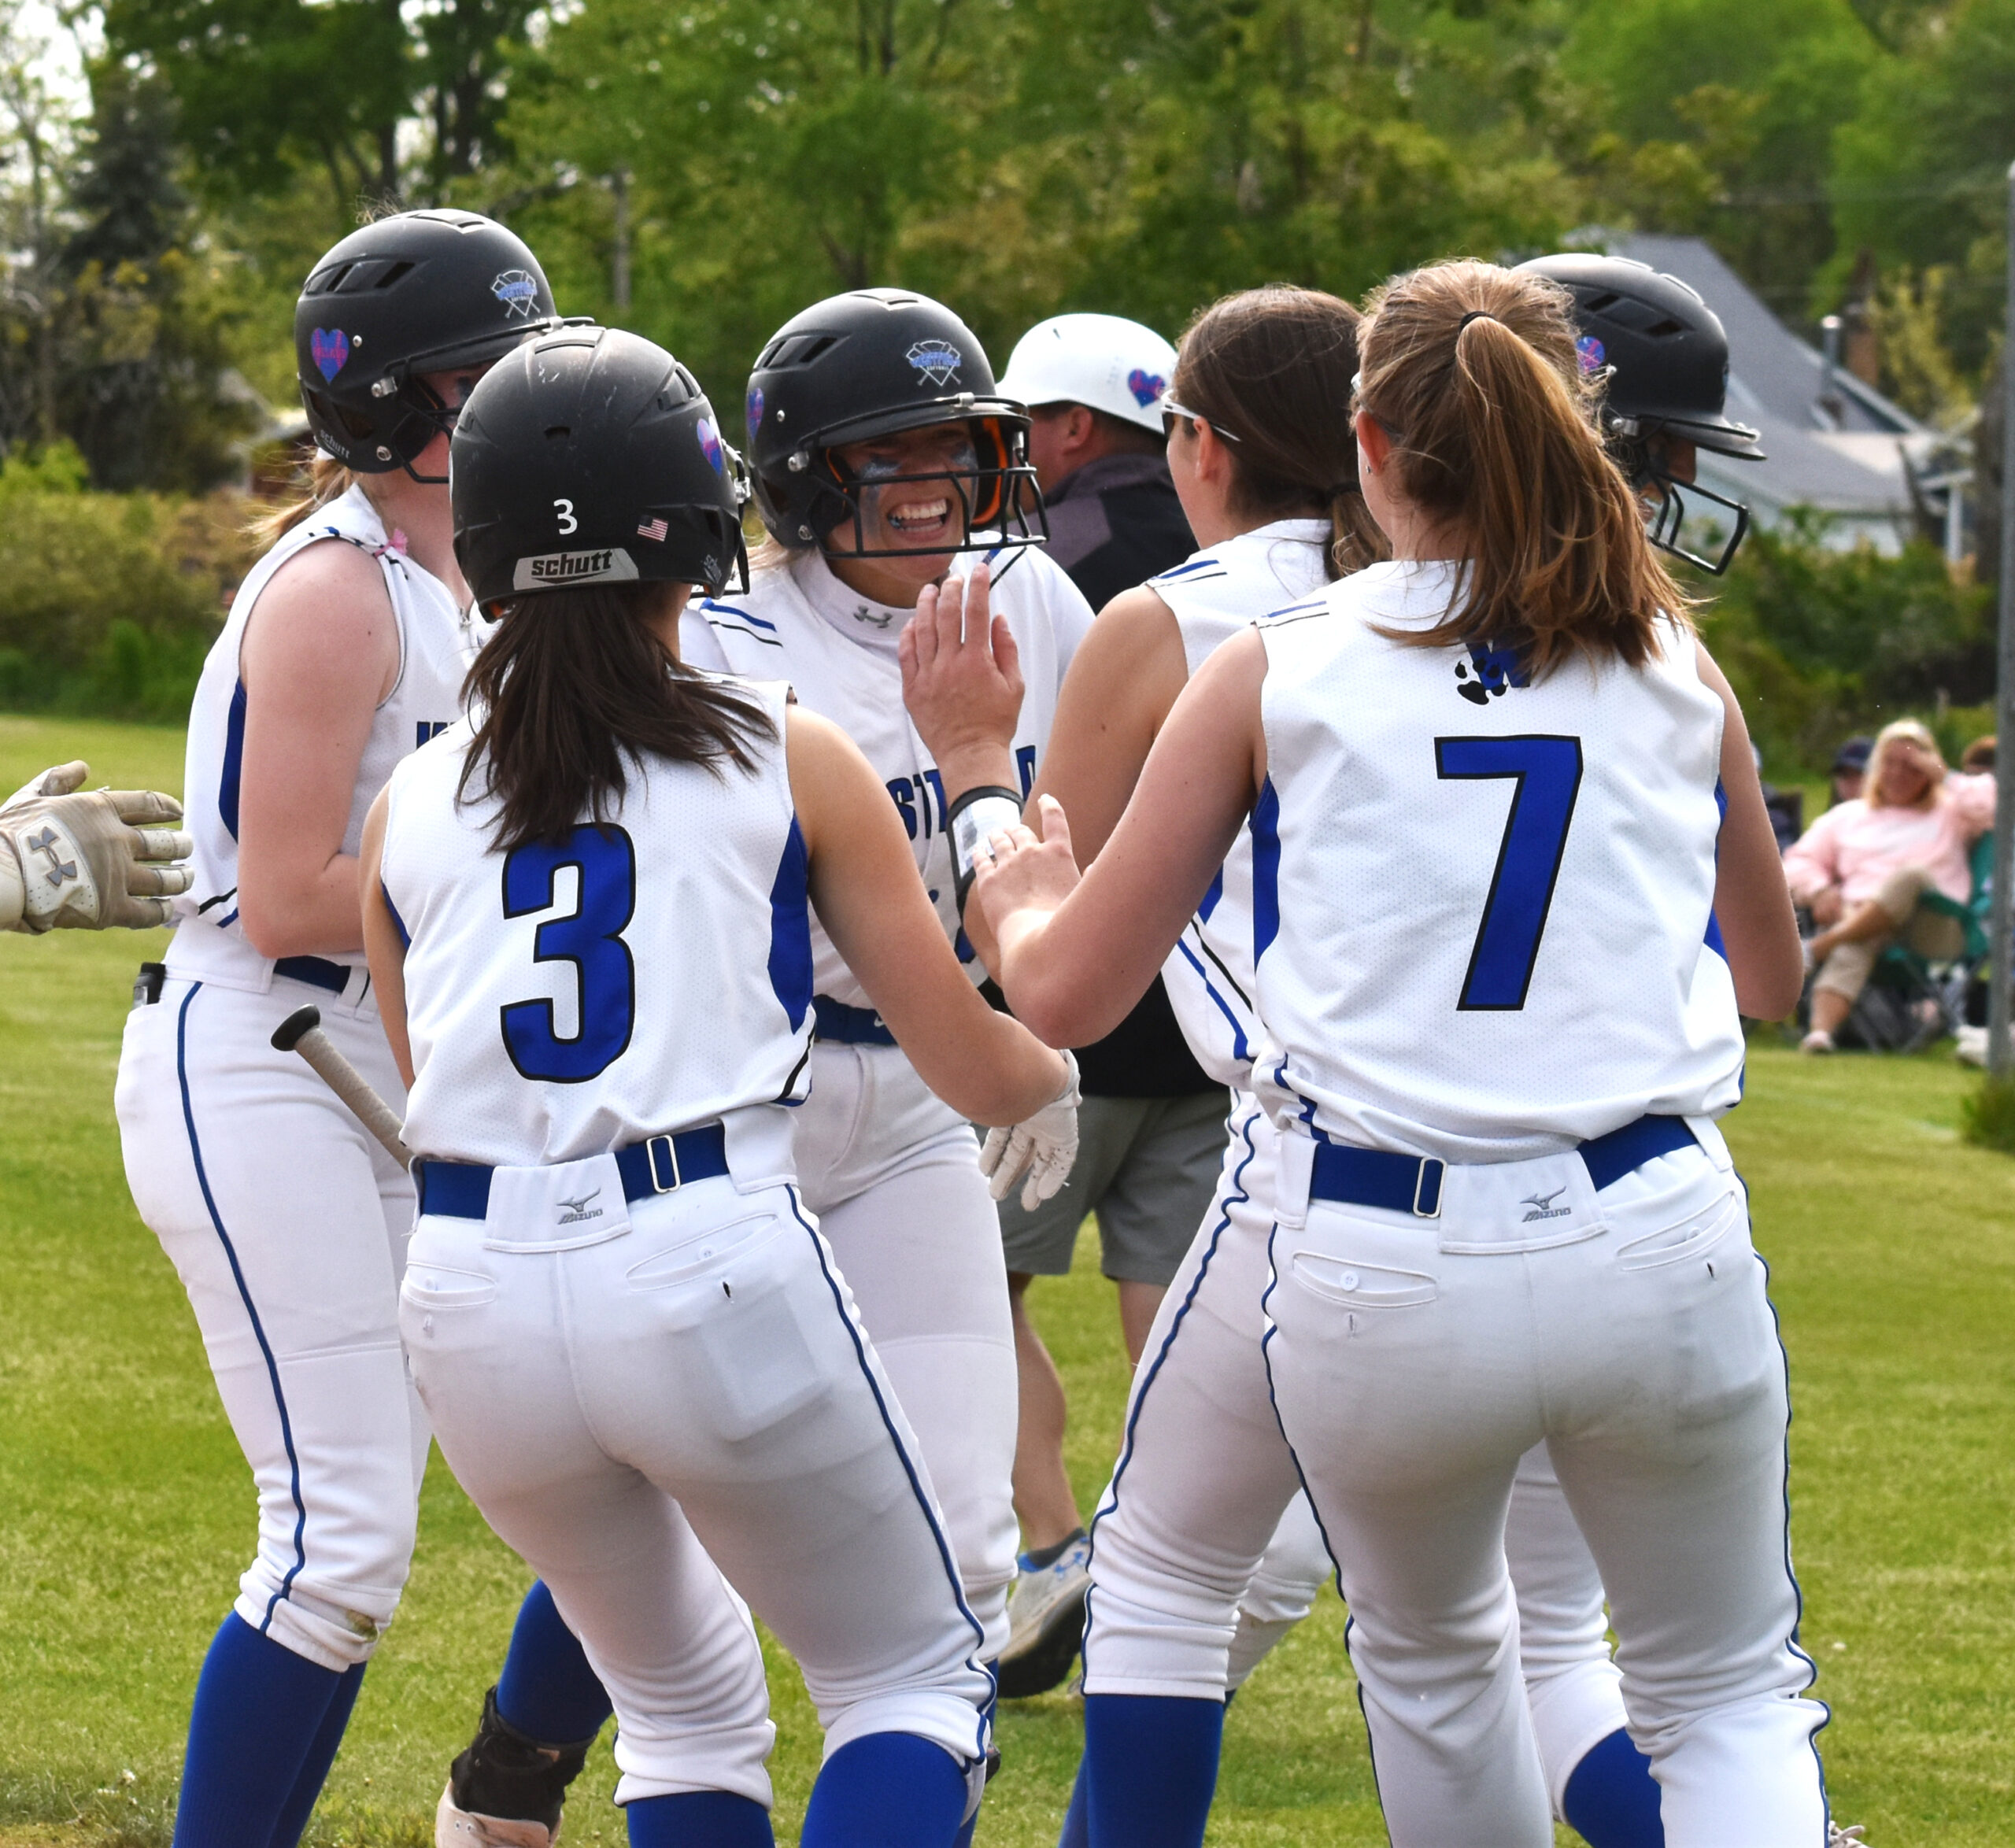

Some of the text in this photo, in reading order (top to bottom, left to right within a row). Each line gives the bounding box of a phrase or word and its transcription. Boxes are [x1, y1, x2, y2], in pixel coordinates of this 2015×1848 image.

[531, 549, 613, 577] schutt
[553, 498, 579, 535] 3
[1433, 733, 1584, 1011] 7
[499, 822, 637, 1085] 3
